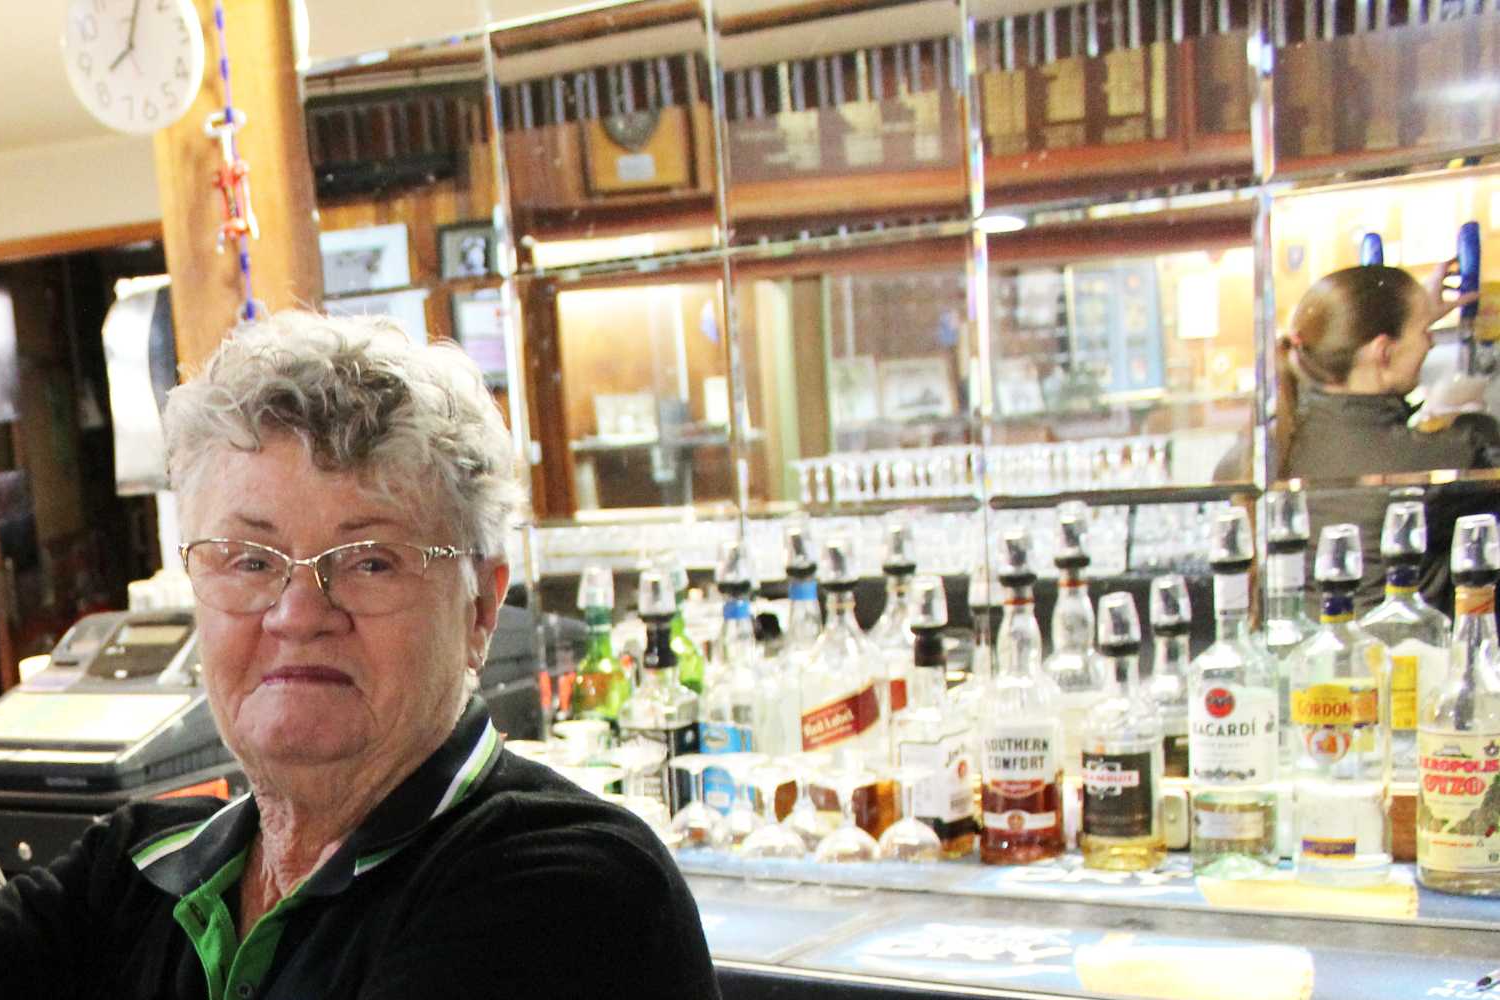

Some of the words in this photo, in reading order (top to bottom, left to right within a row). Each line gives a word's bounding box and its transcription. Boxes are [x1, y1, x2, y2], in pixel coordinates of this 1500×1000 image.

[77, 51, 92, 77] 9
[174, 55, 190, 79] 4
[120, 94, 135, 121] 7
[161, 80, 179, 110] 5
[142, 96, 159, 121] 6
